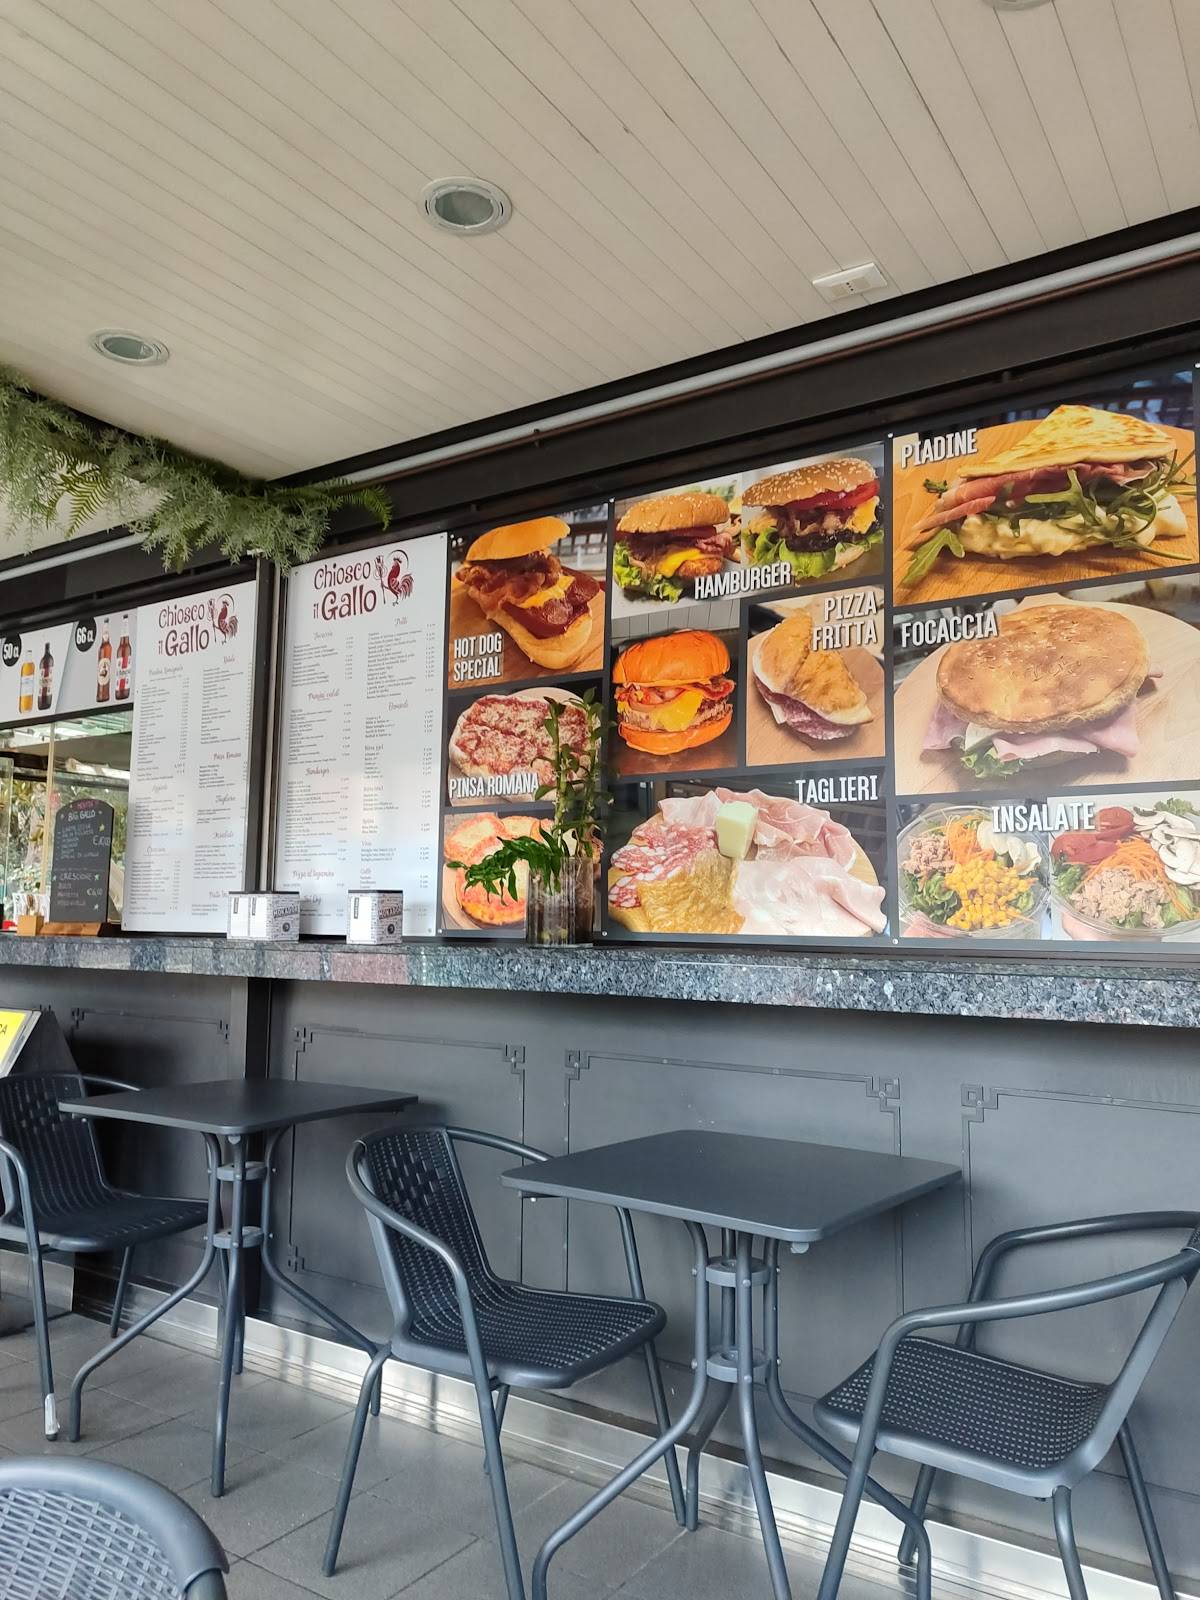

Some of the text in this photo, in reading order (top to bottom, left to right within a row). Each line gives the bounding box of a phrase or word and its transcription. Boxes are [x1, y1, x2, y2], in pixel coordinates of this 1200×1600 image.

[901, 428, 977, 468] PIADINE
[313, 562, 371, 590] Chiosco
[694, 561, 791, 600] HAMBURGER
[158, 604, 205, 628] Chiosco
[313, 584, 377, 621] il Gallo
[824, 591, 877, 622] PIZZA
[76, 626, 87, 644] 66
[165, 624, 209, 656] Gallo
[812, 620, 877, 651] FRITTA
[901, 611, 998, 648] FOCACCIA
[3, 643, 13, 660] 50
[454, 632, 502, 659] HOT DOG
[453, 656, 501, 682] SPECIAL
[449, 772, 539, 798] PINSA ROMANA
[795, 774, 878, 804] TAGLIERI
[992, 801, 1096, 834] INSALATE
